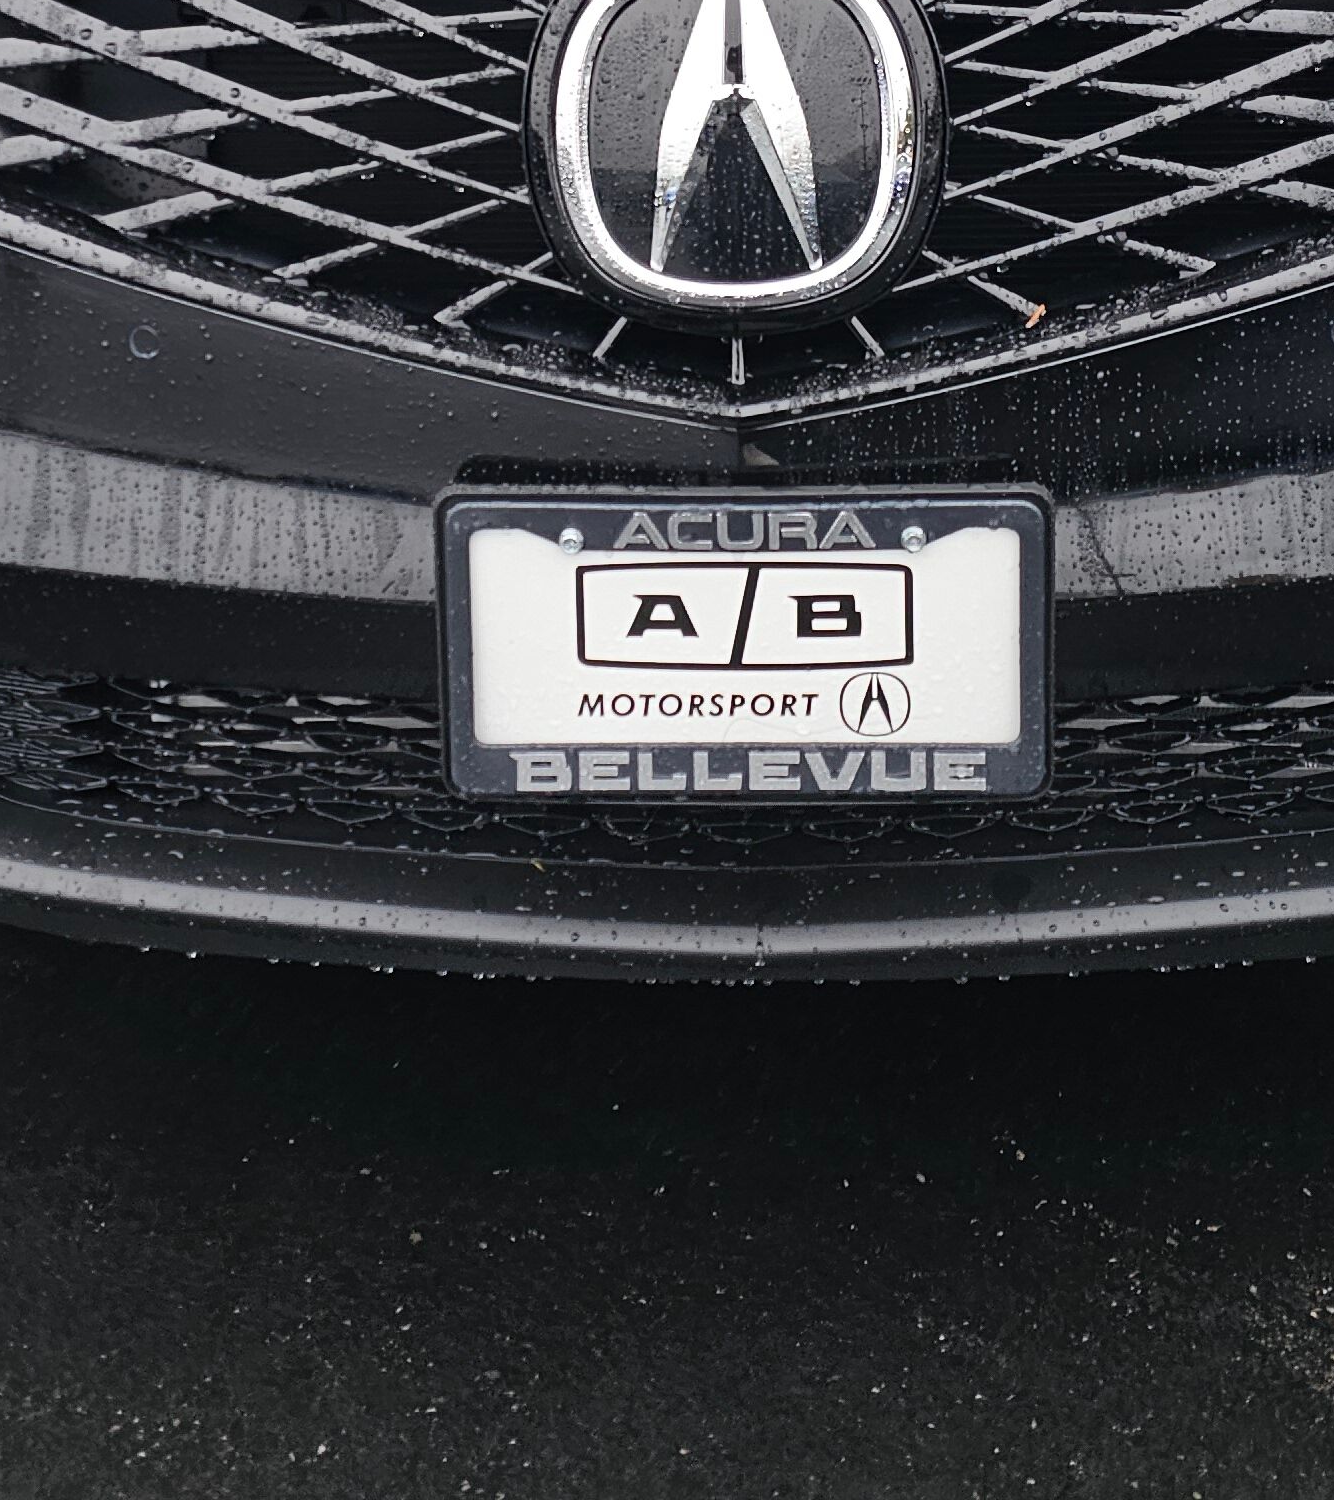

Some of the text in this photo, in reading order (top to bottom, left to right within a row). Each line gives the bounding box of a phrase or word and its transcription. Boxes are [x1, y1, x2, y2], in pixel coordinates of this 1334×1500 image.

[612, 511, 877, 552] ACURA
[577, 693, 820, 717] MOTORSPORT
[509, 751, 988, 792] BELLEVUE
